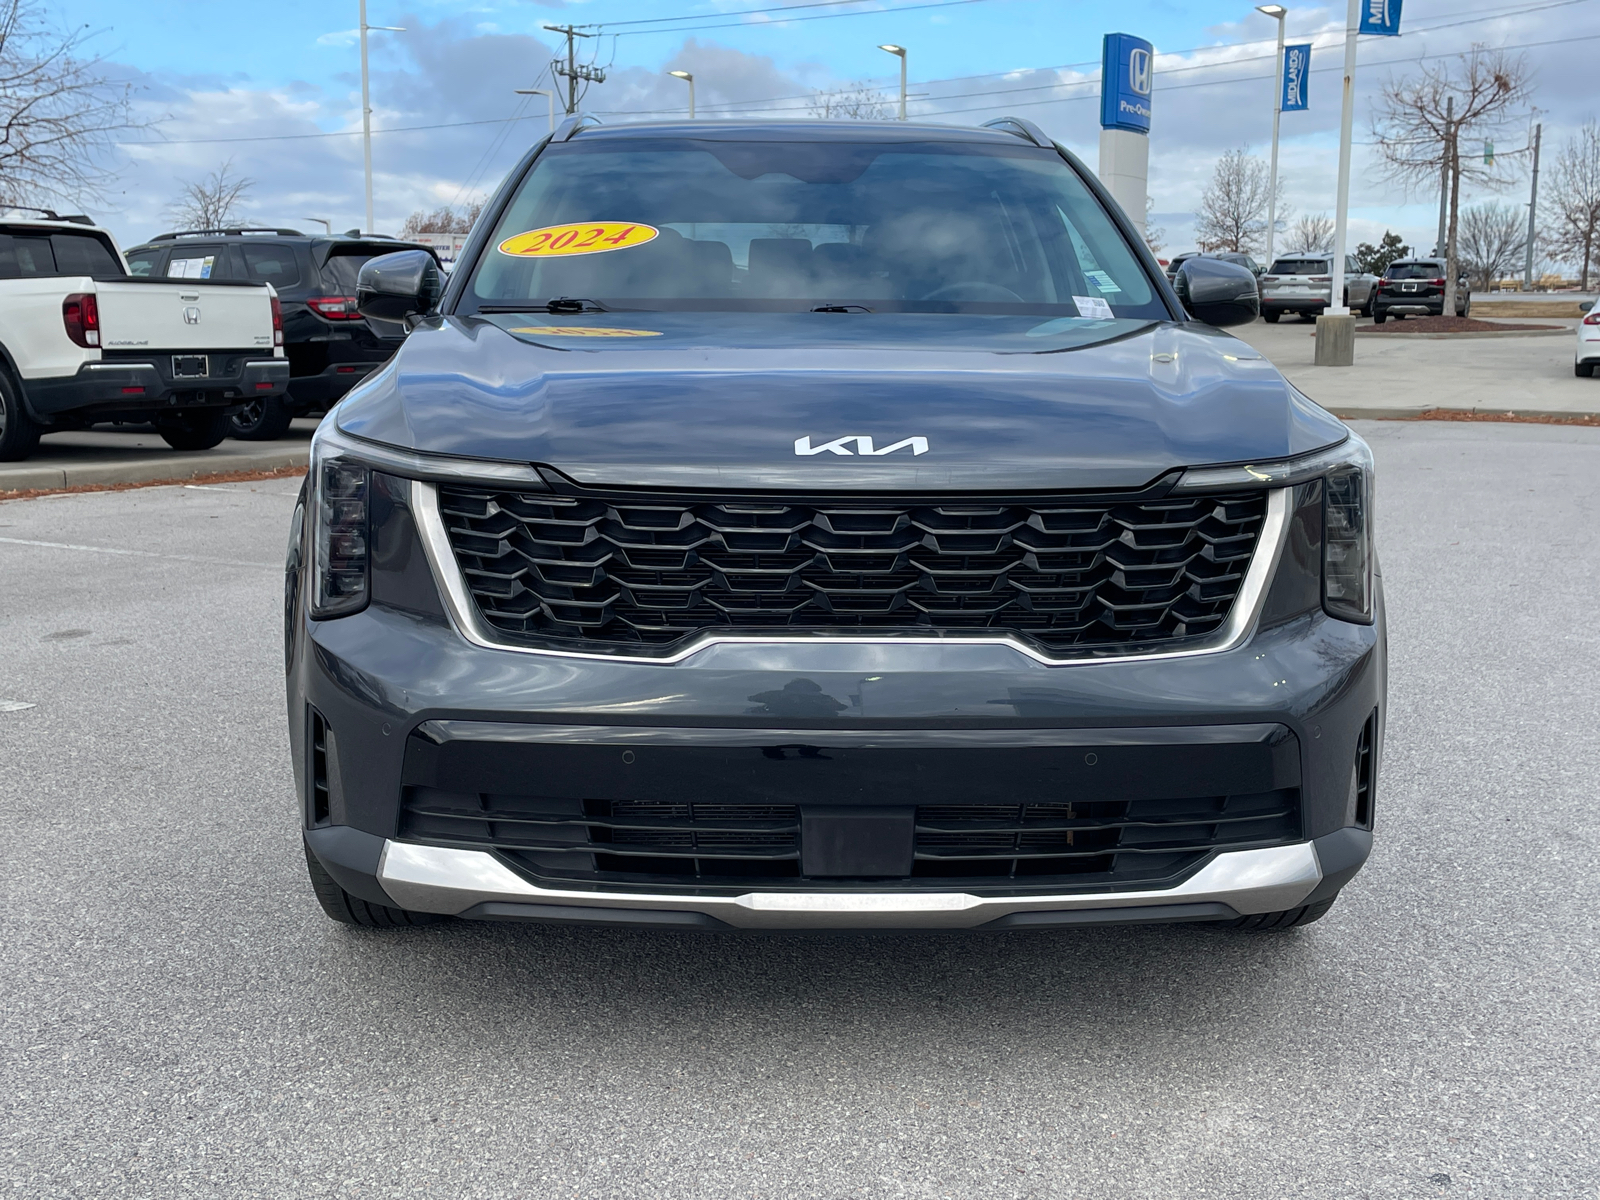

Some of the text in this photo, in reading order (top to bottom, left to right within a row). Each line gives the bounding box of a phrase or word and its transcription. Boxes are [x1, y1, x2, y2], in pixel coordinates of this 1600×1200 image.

[1287, 49, 1299, 105] MIDLANDS
[520, 226, 637, 253] 2024
[794, 435, 929, 456] KIA
